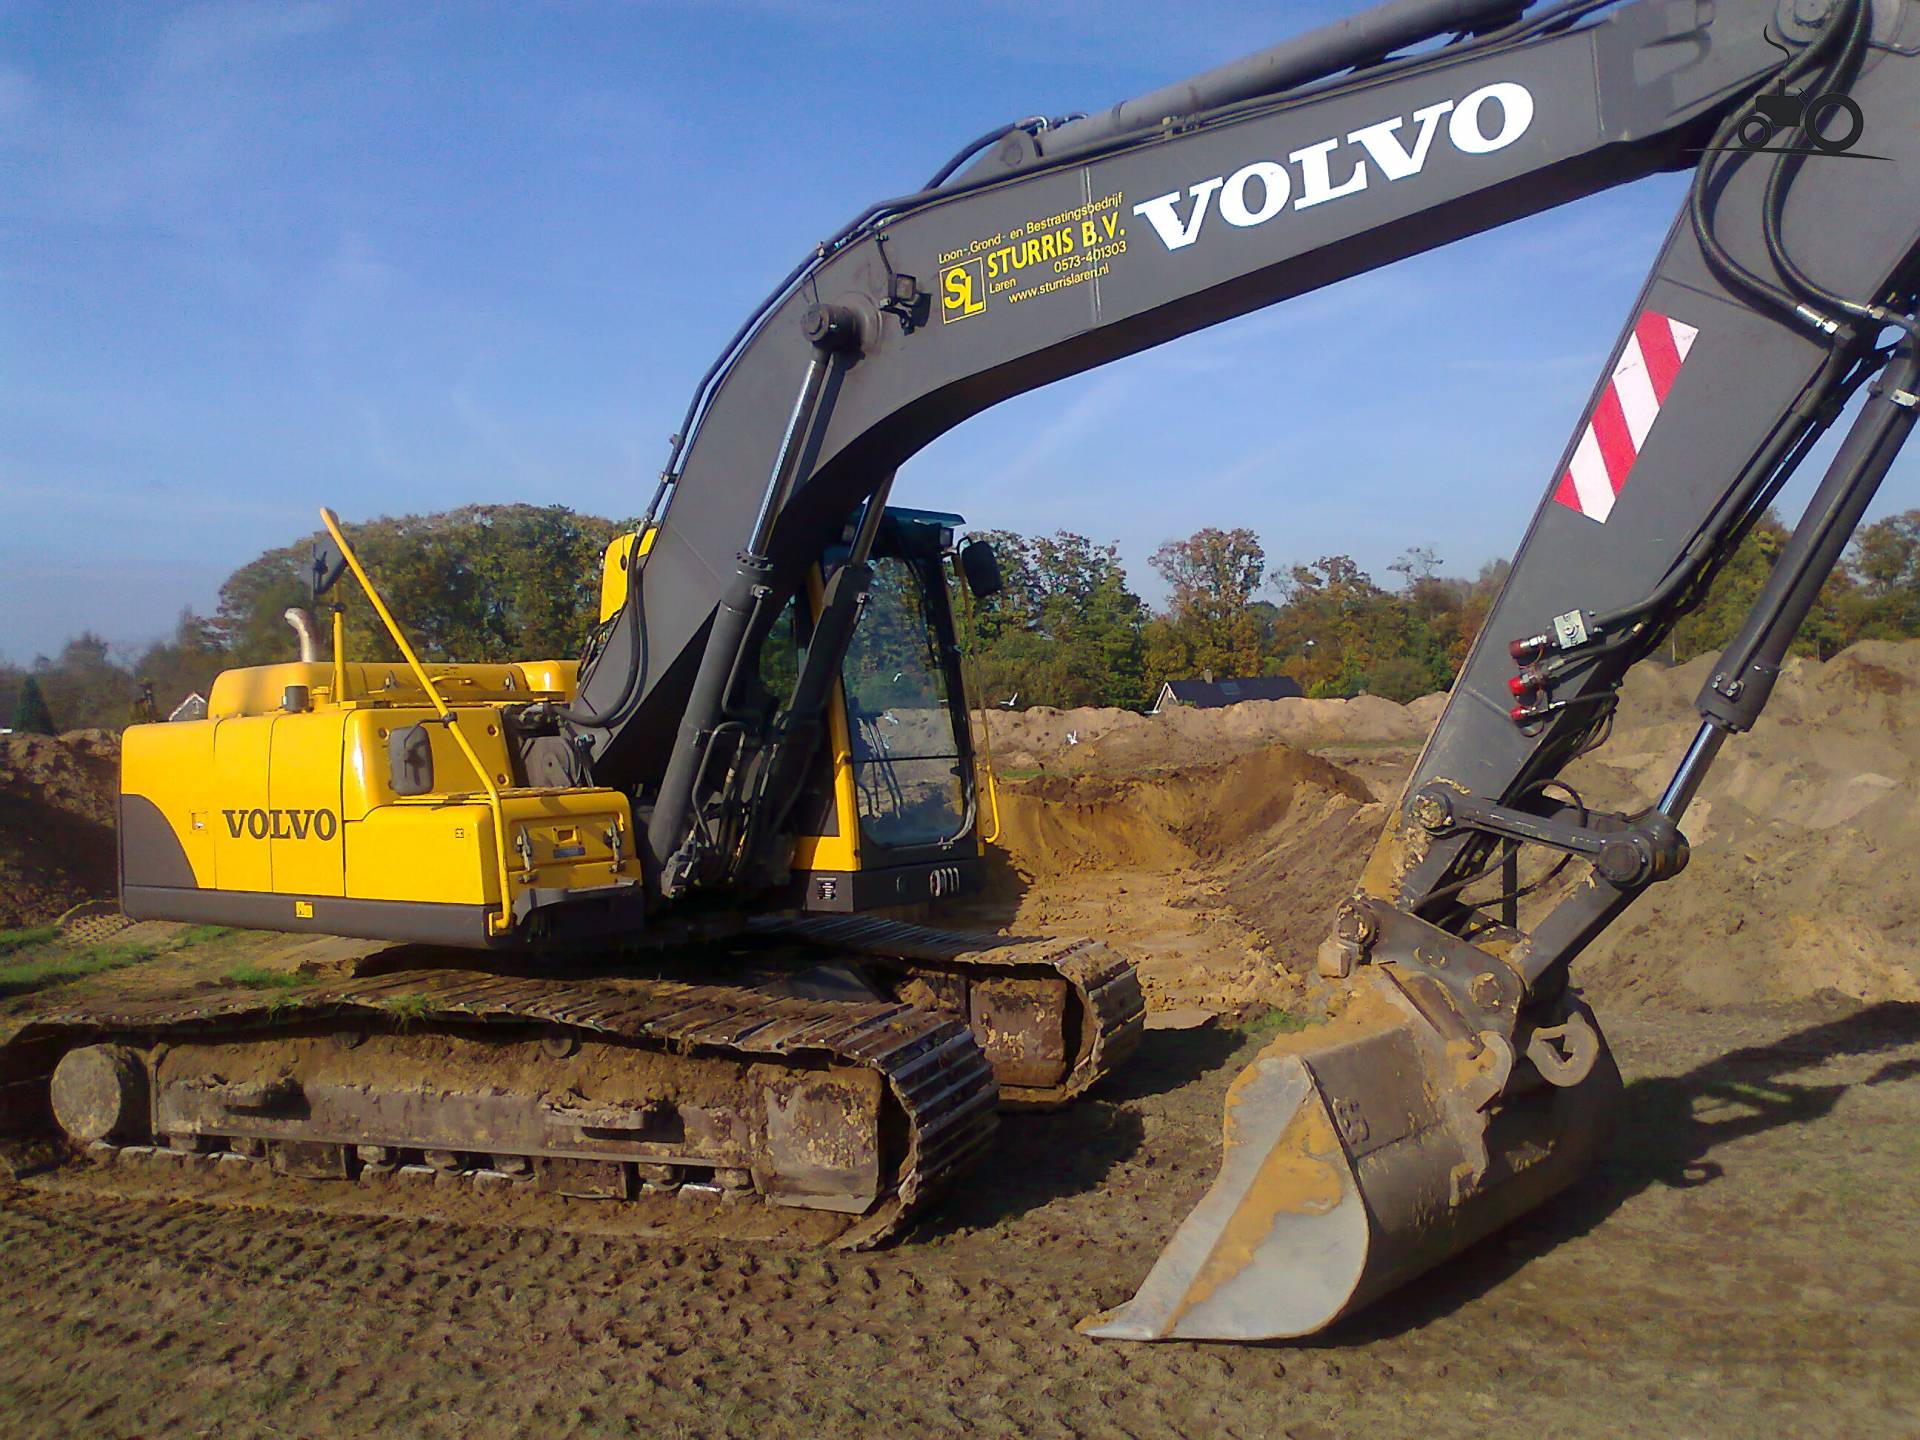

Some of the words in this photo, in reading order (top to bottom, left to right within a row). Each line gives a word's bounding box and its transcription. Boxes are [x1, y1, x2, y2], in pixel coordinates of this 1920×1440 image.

[1133, 82, 1534, 251] VOLVO
[1010, 228, 1024, 240] en
[1026, 192, 1123, 234] Bestratingsbedrijf
[988, 227, 1074, 278] STURRIS
[1081, 211, 1126, 248] B.V.
[1054, 240, 1127, 273] 0573-401303
[944, 267, 984, 314] SL
[989, 278, 1017, 294] Laren
[1008, 263, 1110, 303] www.sturrislaren.nl
[222, 808, 337, 841] VOLVO
